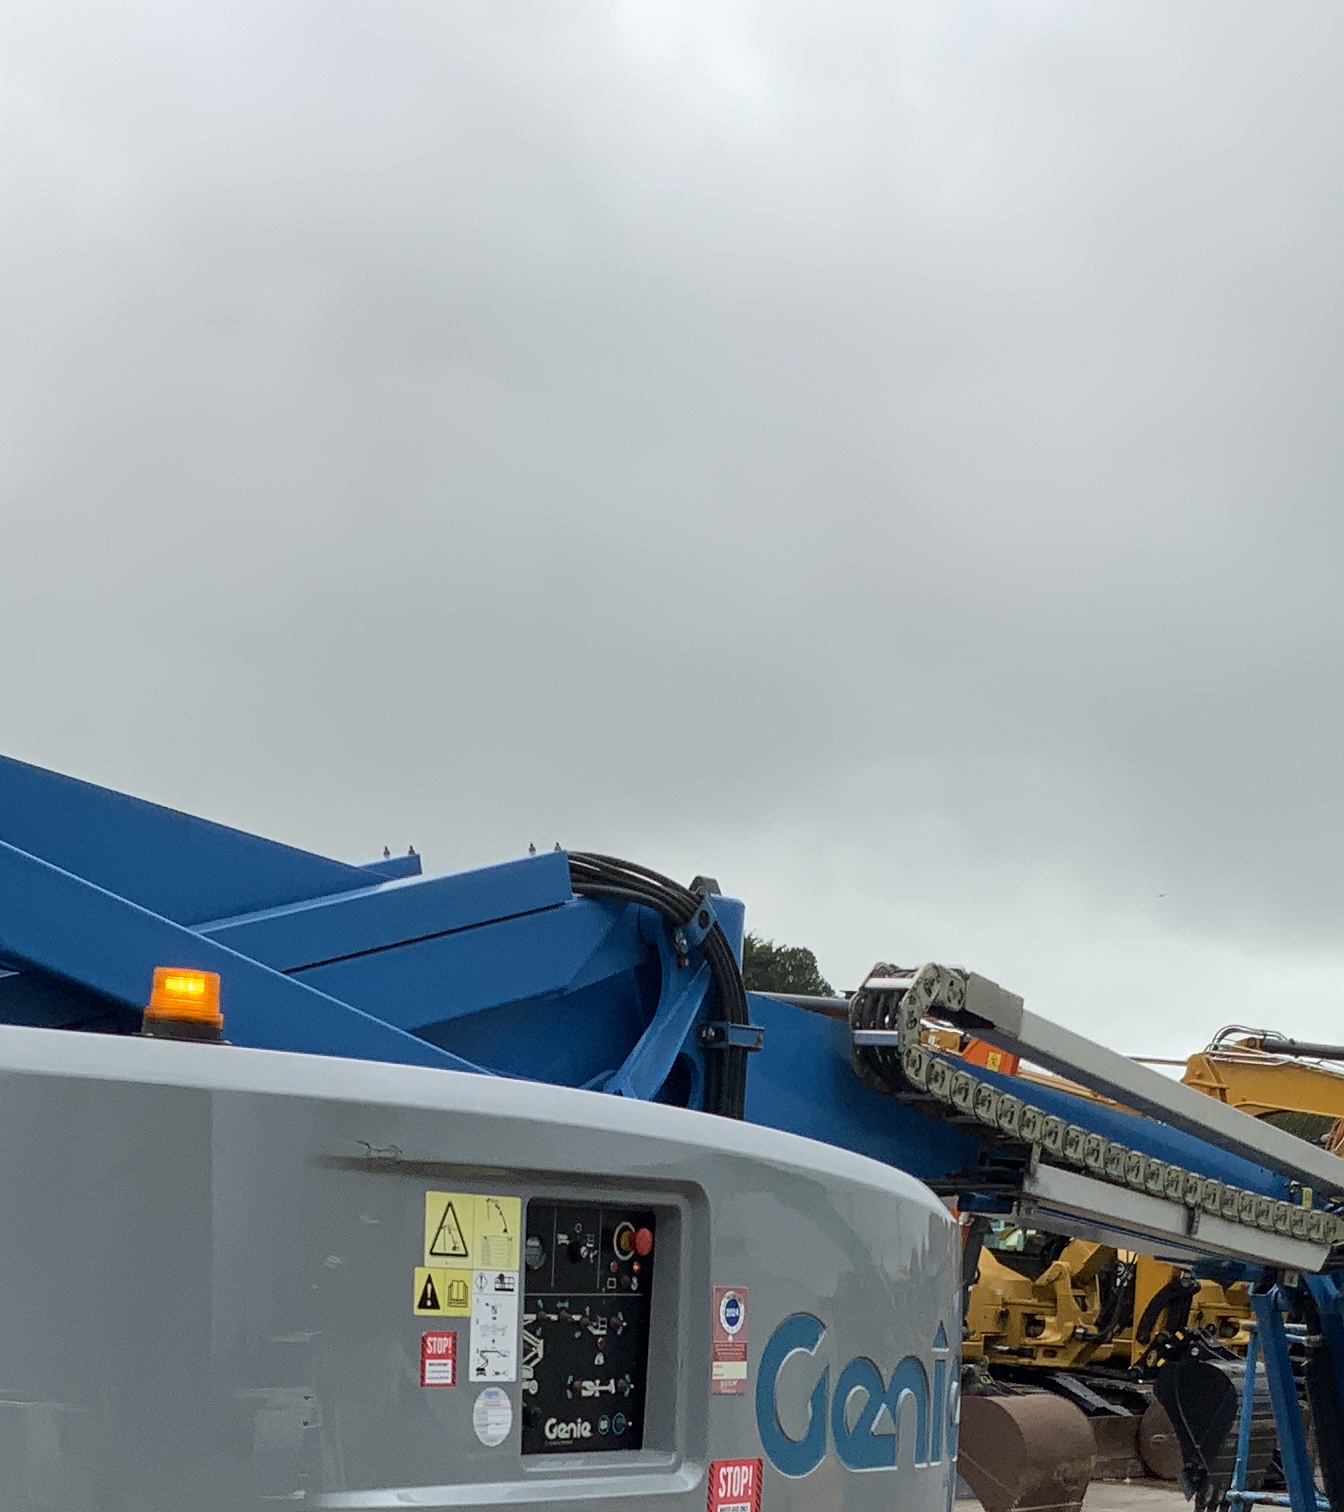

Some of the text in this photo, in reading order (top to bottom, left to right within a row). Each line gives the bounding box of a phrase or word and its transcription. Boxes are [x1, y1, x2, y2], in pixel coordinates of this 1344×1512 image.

[426, 1337, 453, 1355] STOP!
[544, 1417, 594, 1440] Genie
[718, 1464, 754, 1498] STOP!
